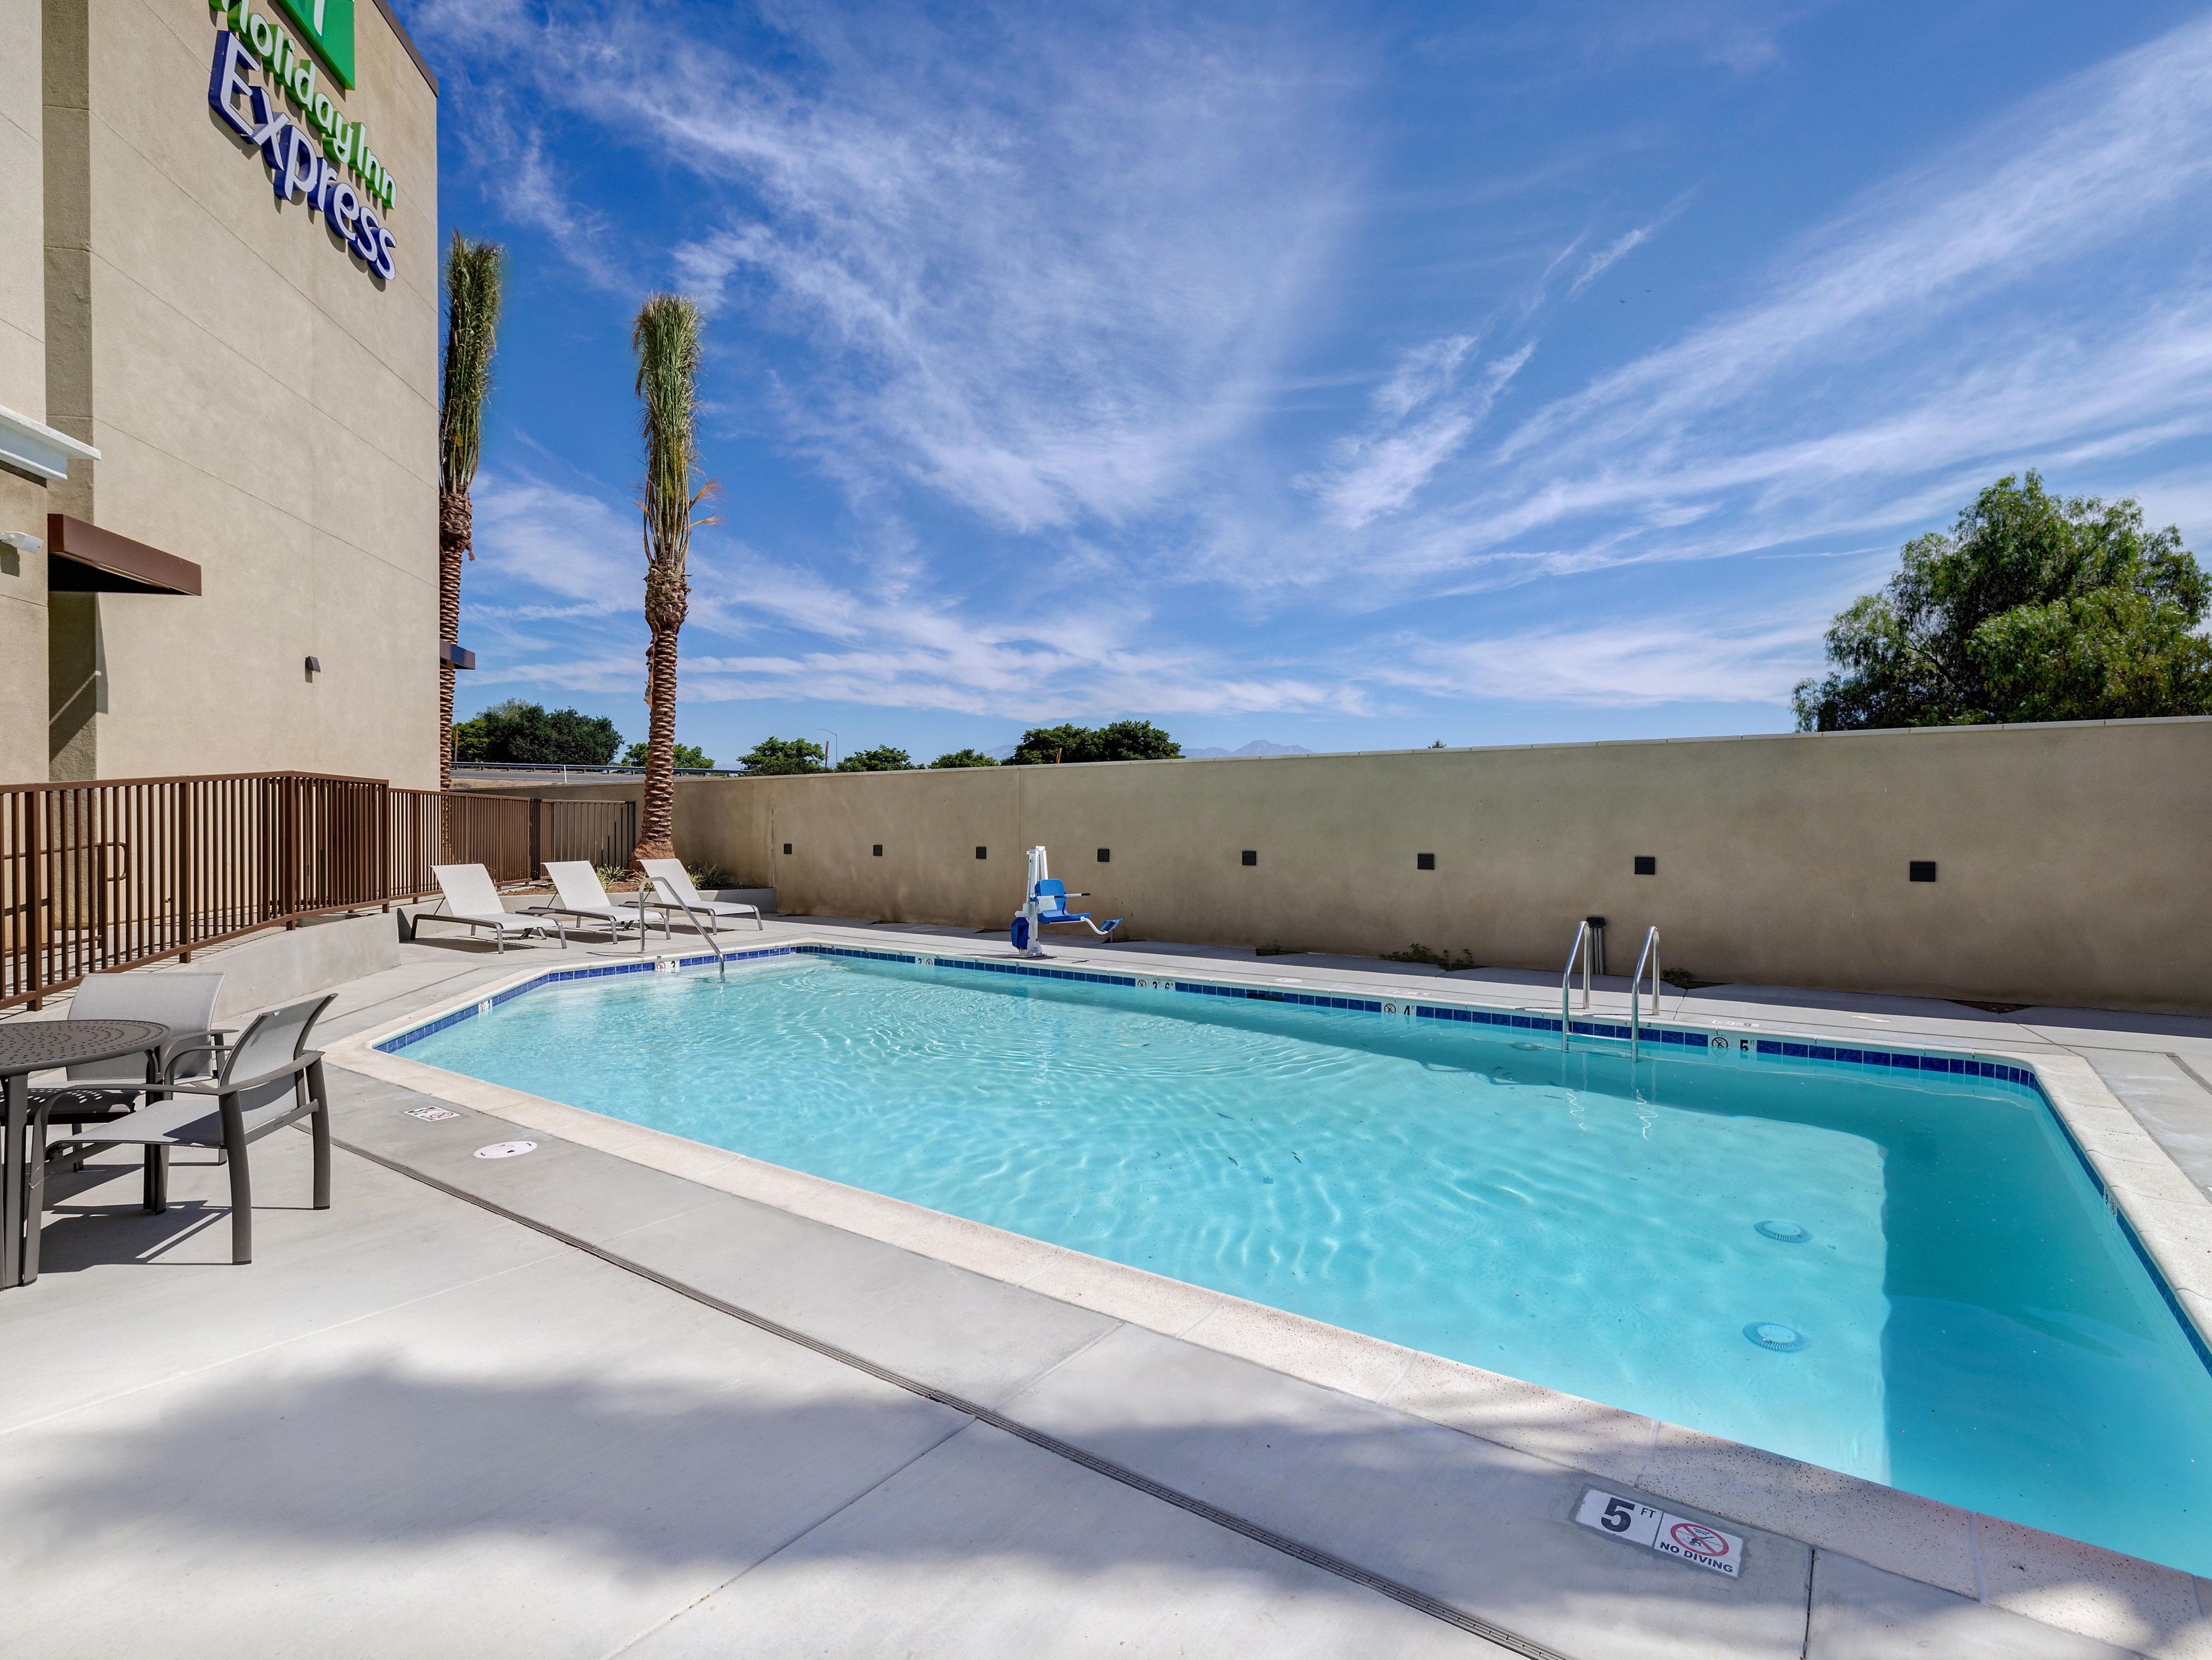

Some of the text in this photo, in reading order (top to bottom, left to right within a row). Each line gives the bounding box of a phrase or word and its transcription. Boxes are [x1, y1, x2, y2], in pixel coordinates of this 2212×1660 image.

[208, 30, 397, 280] Express
[349, 122, 397, 210] Inn
[1404, 1005, 1410, 1016] 4
[1740, 1039, 1749, 1051] 5
[1600, 1497, 1656, 1532] 5 FT
[1660, 1542, 1733, 1573] NO DIVING
